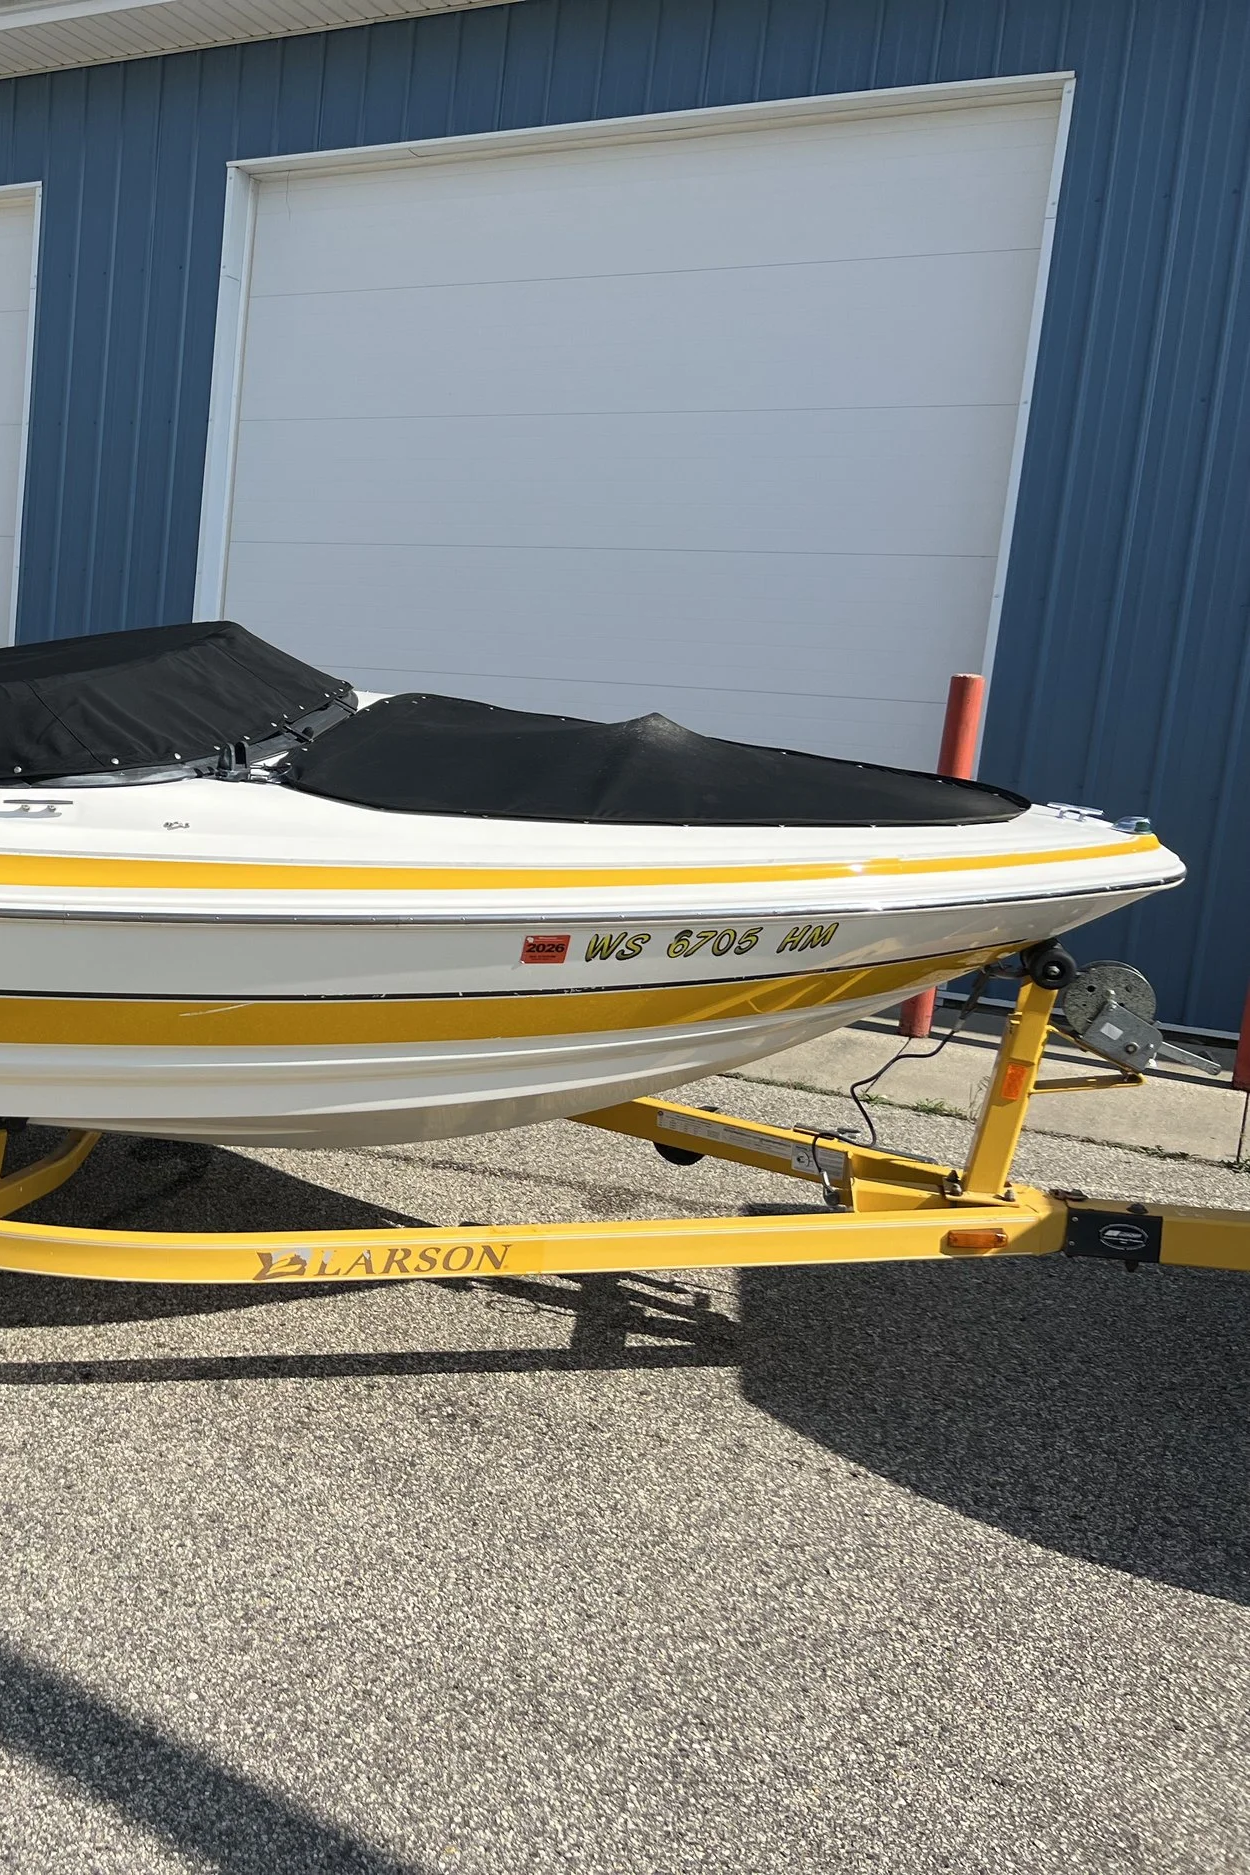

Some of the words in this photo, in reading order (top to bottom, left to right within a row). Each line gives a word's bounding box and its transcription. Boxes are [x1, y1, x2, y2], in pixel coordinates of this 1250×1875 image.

[525, 943, 566, 953] 2026
[584, 931, 652, 963] WS
[666, 926, 764, 959] 6705
[775, 922, 840, 954] HM
[313, 1244, 512, 1277] LARSON
